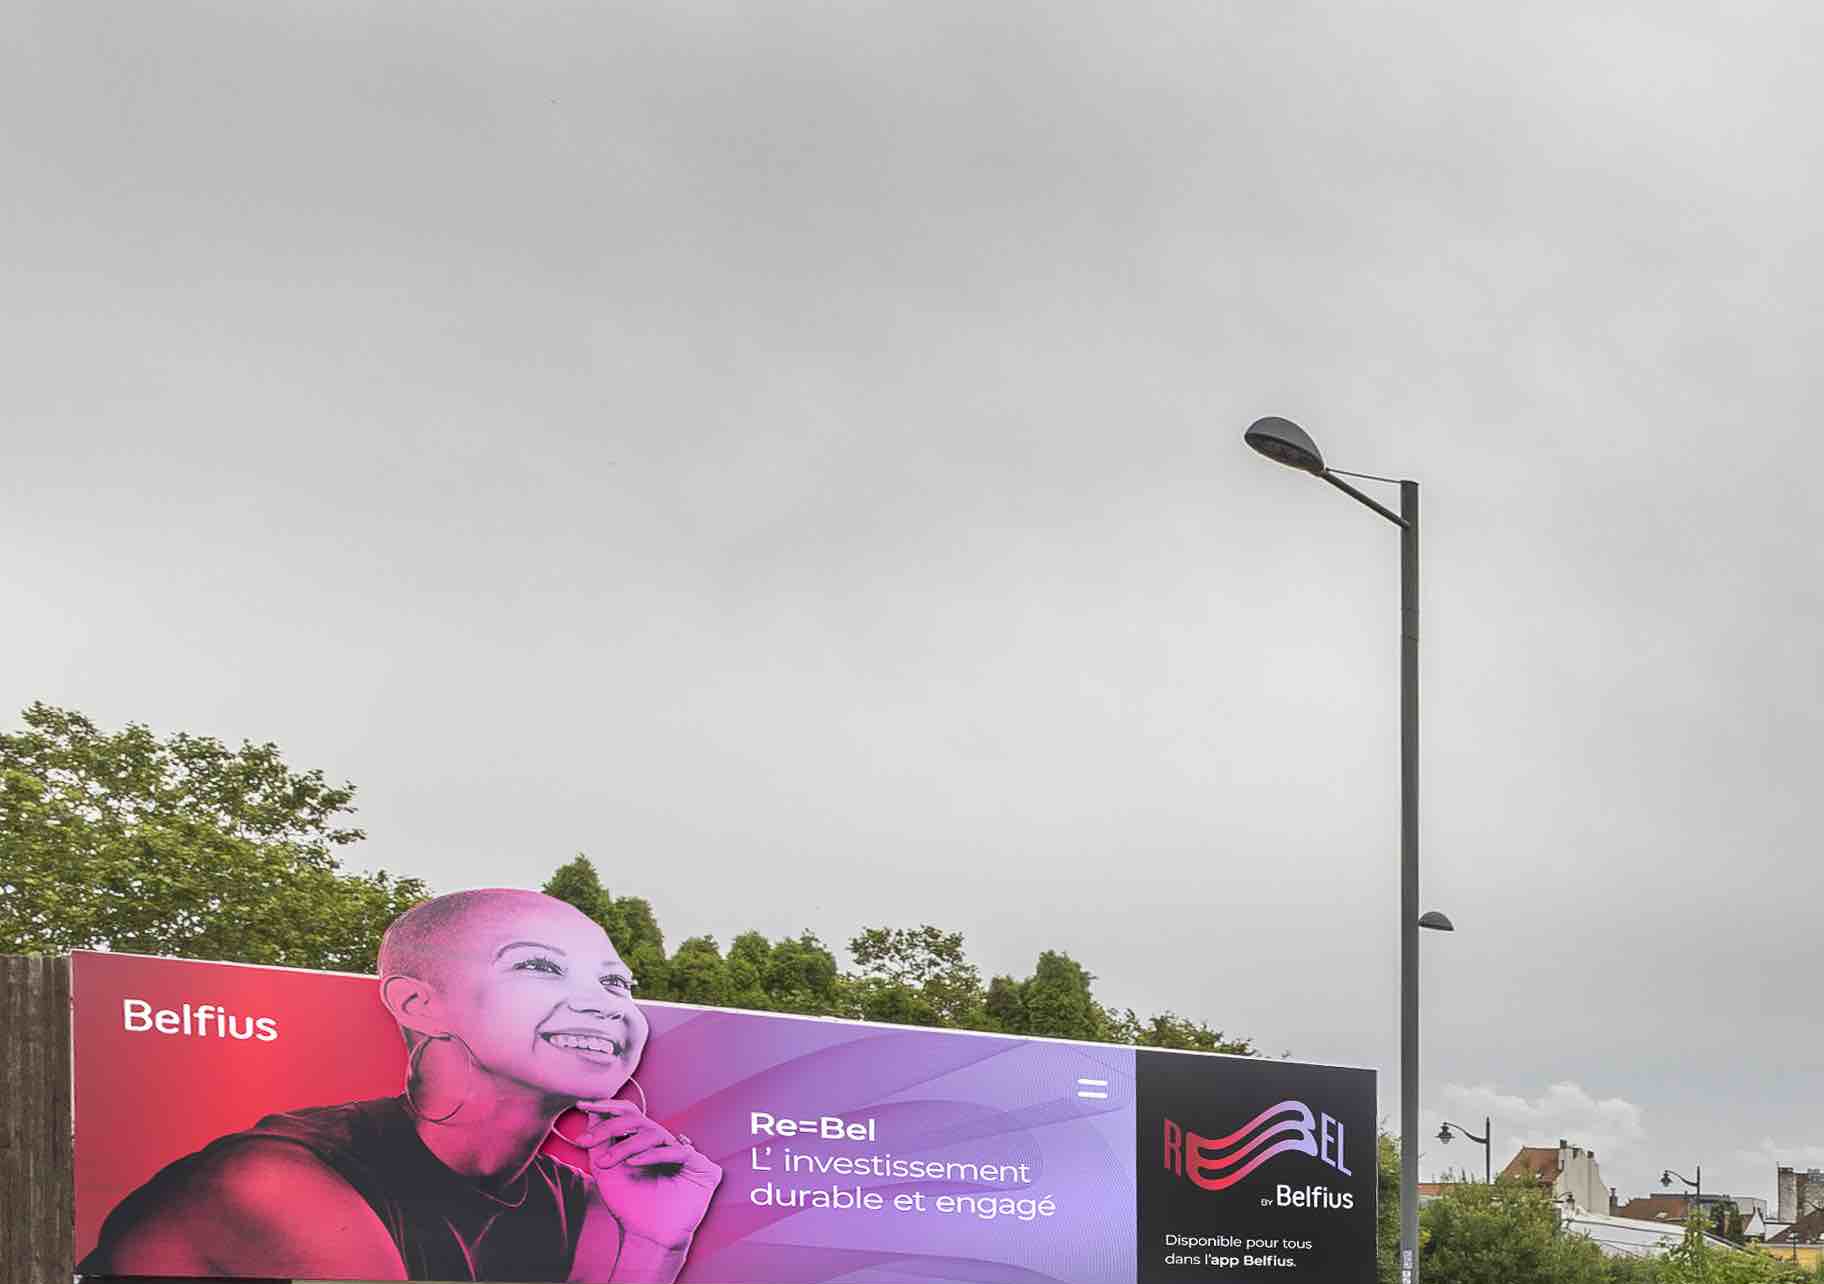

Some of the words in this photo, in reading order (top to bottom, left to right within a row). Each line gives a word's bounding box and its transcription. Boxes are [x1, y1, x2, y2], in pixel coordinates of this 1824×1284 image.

[123, 998, 278, 1042] Belfius
[751, 1112, 876, 1141] Re=Bel
[784, 1148, 1032, 1184] investissement
[750, 1182, 884, 1211] durable
[893, 1190, 926, 1212] et
[935, 1195, 1057, 1221] engagé
[1260, 1199, 1273, 1207] BY
[1276, 1184, 1354, 1209] Belfius
[1165, 1234, 1242, 1249] Disponible
[1246, 1239, 1280, 1250] pour
[1283, 1239, 1313, 1250] tous
[1164, 1253, 1201, 1265] dans
[1243, 1255, 1297, 1268] Belfius.
